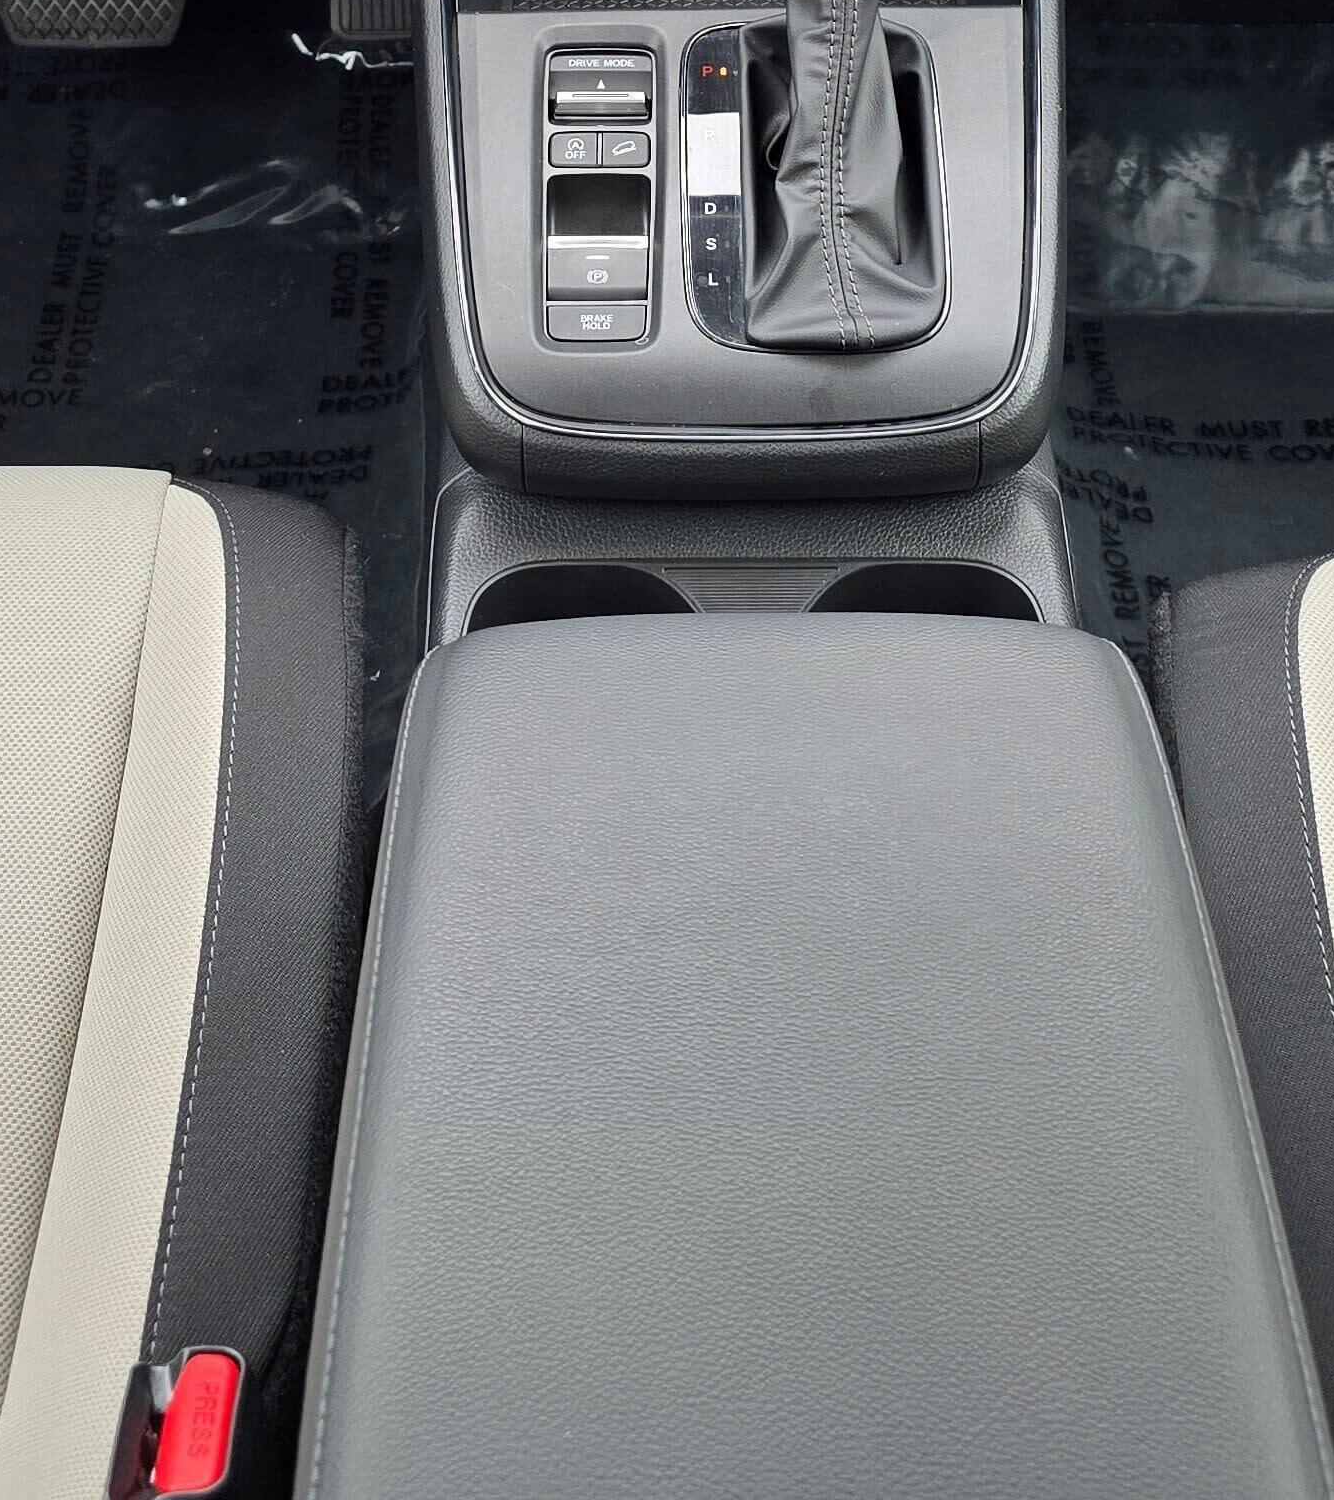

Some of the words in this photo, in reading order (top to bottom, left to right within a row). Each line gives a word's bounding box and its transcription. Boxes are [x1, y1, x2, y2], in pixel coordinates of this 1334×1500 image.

[568, 59, 600, 68] DRIVE
[603, 59, 635, 68] MODE
[702, 66, 714, 77] P
[564, 150, 586, 160] OFF
[704, 203, 717, 215] D
[705, 237, 717, 250] S
[707, 273, 719, 286] L
[580, 313, 613, 323] BRAKE
[582, 320, 611, 330] HOLD
[26, 300, 67, 384] DEALER
[1066, 405, 1178, 437] DEALER
[1196, 419, 1284, 439] MUST
[1099, 516, 1141, 622] REMOVE
[186, 1381, 220, 1459] PRESS
